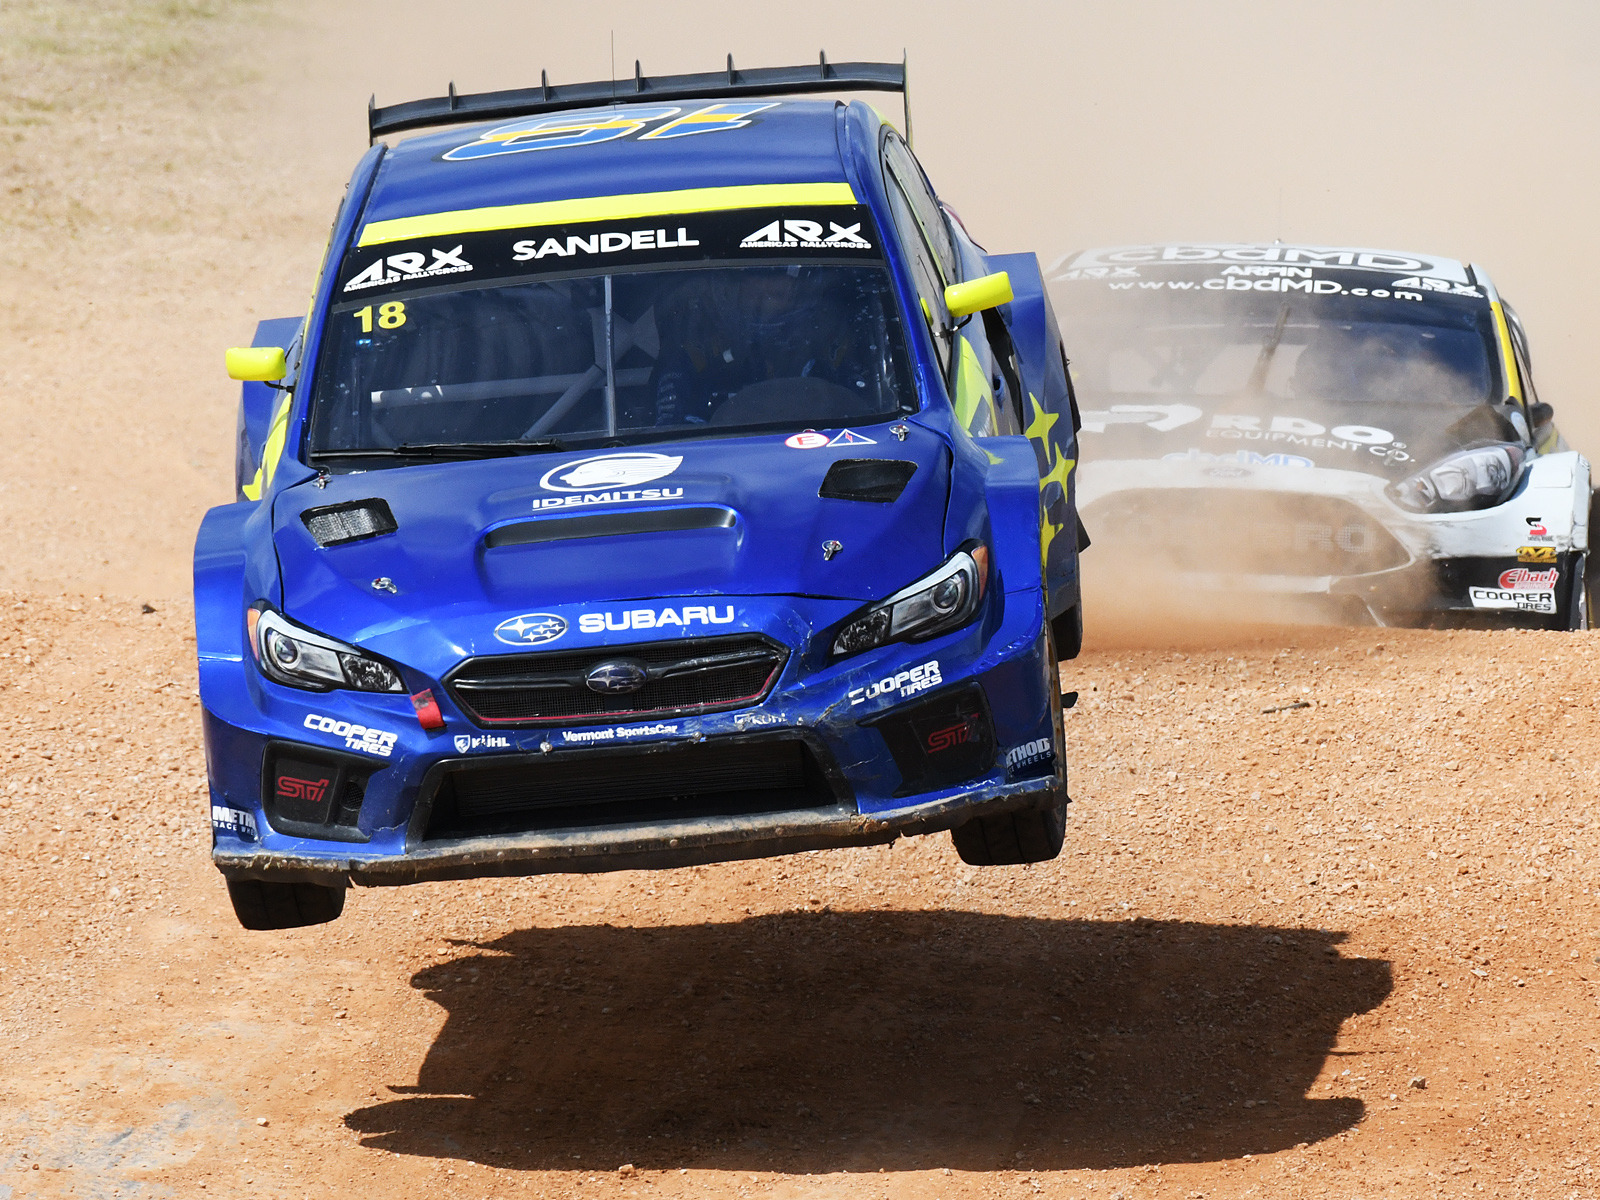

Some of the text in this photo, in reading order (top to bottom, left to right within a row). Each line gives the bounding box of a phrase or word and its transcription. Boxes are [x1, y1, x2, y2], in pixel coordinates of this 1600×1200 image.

[741, 219, 868, 243] ARX
[512, 227, 700, 261] SANDELL
[739, 240, 872, 249] AMERICAS RALLYCROSS
[345, 244, 470, 286] ARX
[1220, 265, 1312, 278] ARPIN
[343, 264, 474, 292] AMERICAS RALLYCROSS
[1108, 276, 1423, 302] www.cbdMD.com
[353, 301, 407, 333] 18
[1205, 429, 1362, 451] EQUIPMENT
[1210, 414, 1395, 444] RDO
[532, 487, 684, 509] IDEMITSU
[1473, 590, 1552, 603] COOPER
[1515, 602, 1552, 611] TIRES
[578, 605, 735, 634] SUBARU
[901, 673, 943, 698] TIRES
[303, 713, 398, 747] COOPER
[562, 724, 678, 742] Vermont SportsCar
[345, 736, 394, 757] TIRES
[212, 820, 238, 832] RACE
